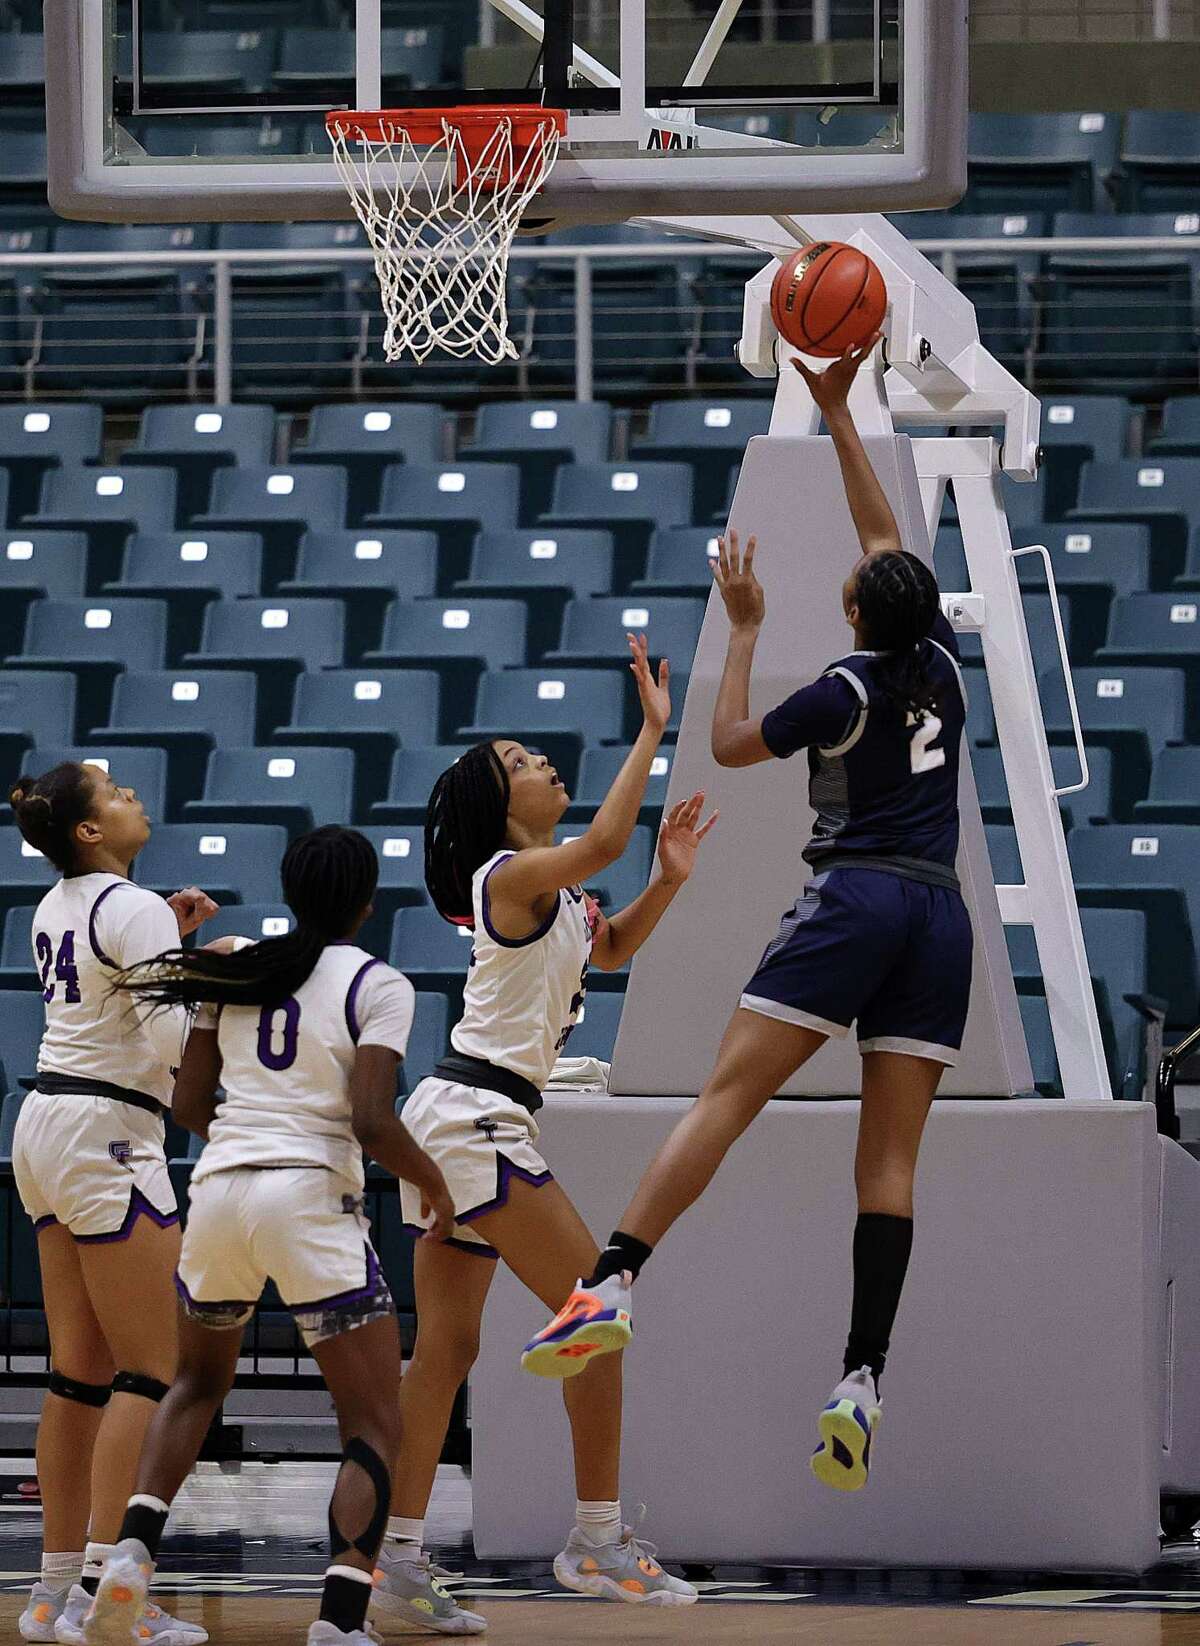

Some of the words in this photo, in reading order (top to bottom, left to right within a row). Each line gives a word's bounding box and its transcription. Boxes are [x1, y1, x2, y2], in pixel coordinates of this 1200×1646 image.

[905, 708, 946, 774] 2
[35, 930, 81, 1004] 24
[256, 994, 302, 1072] 0
